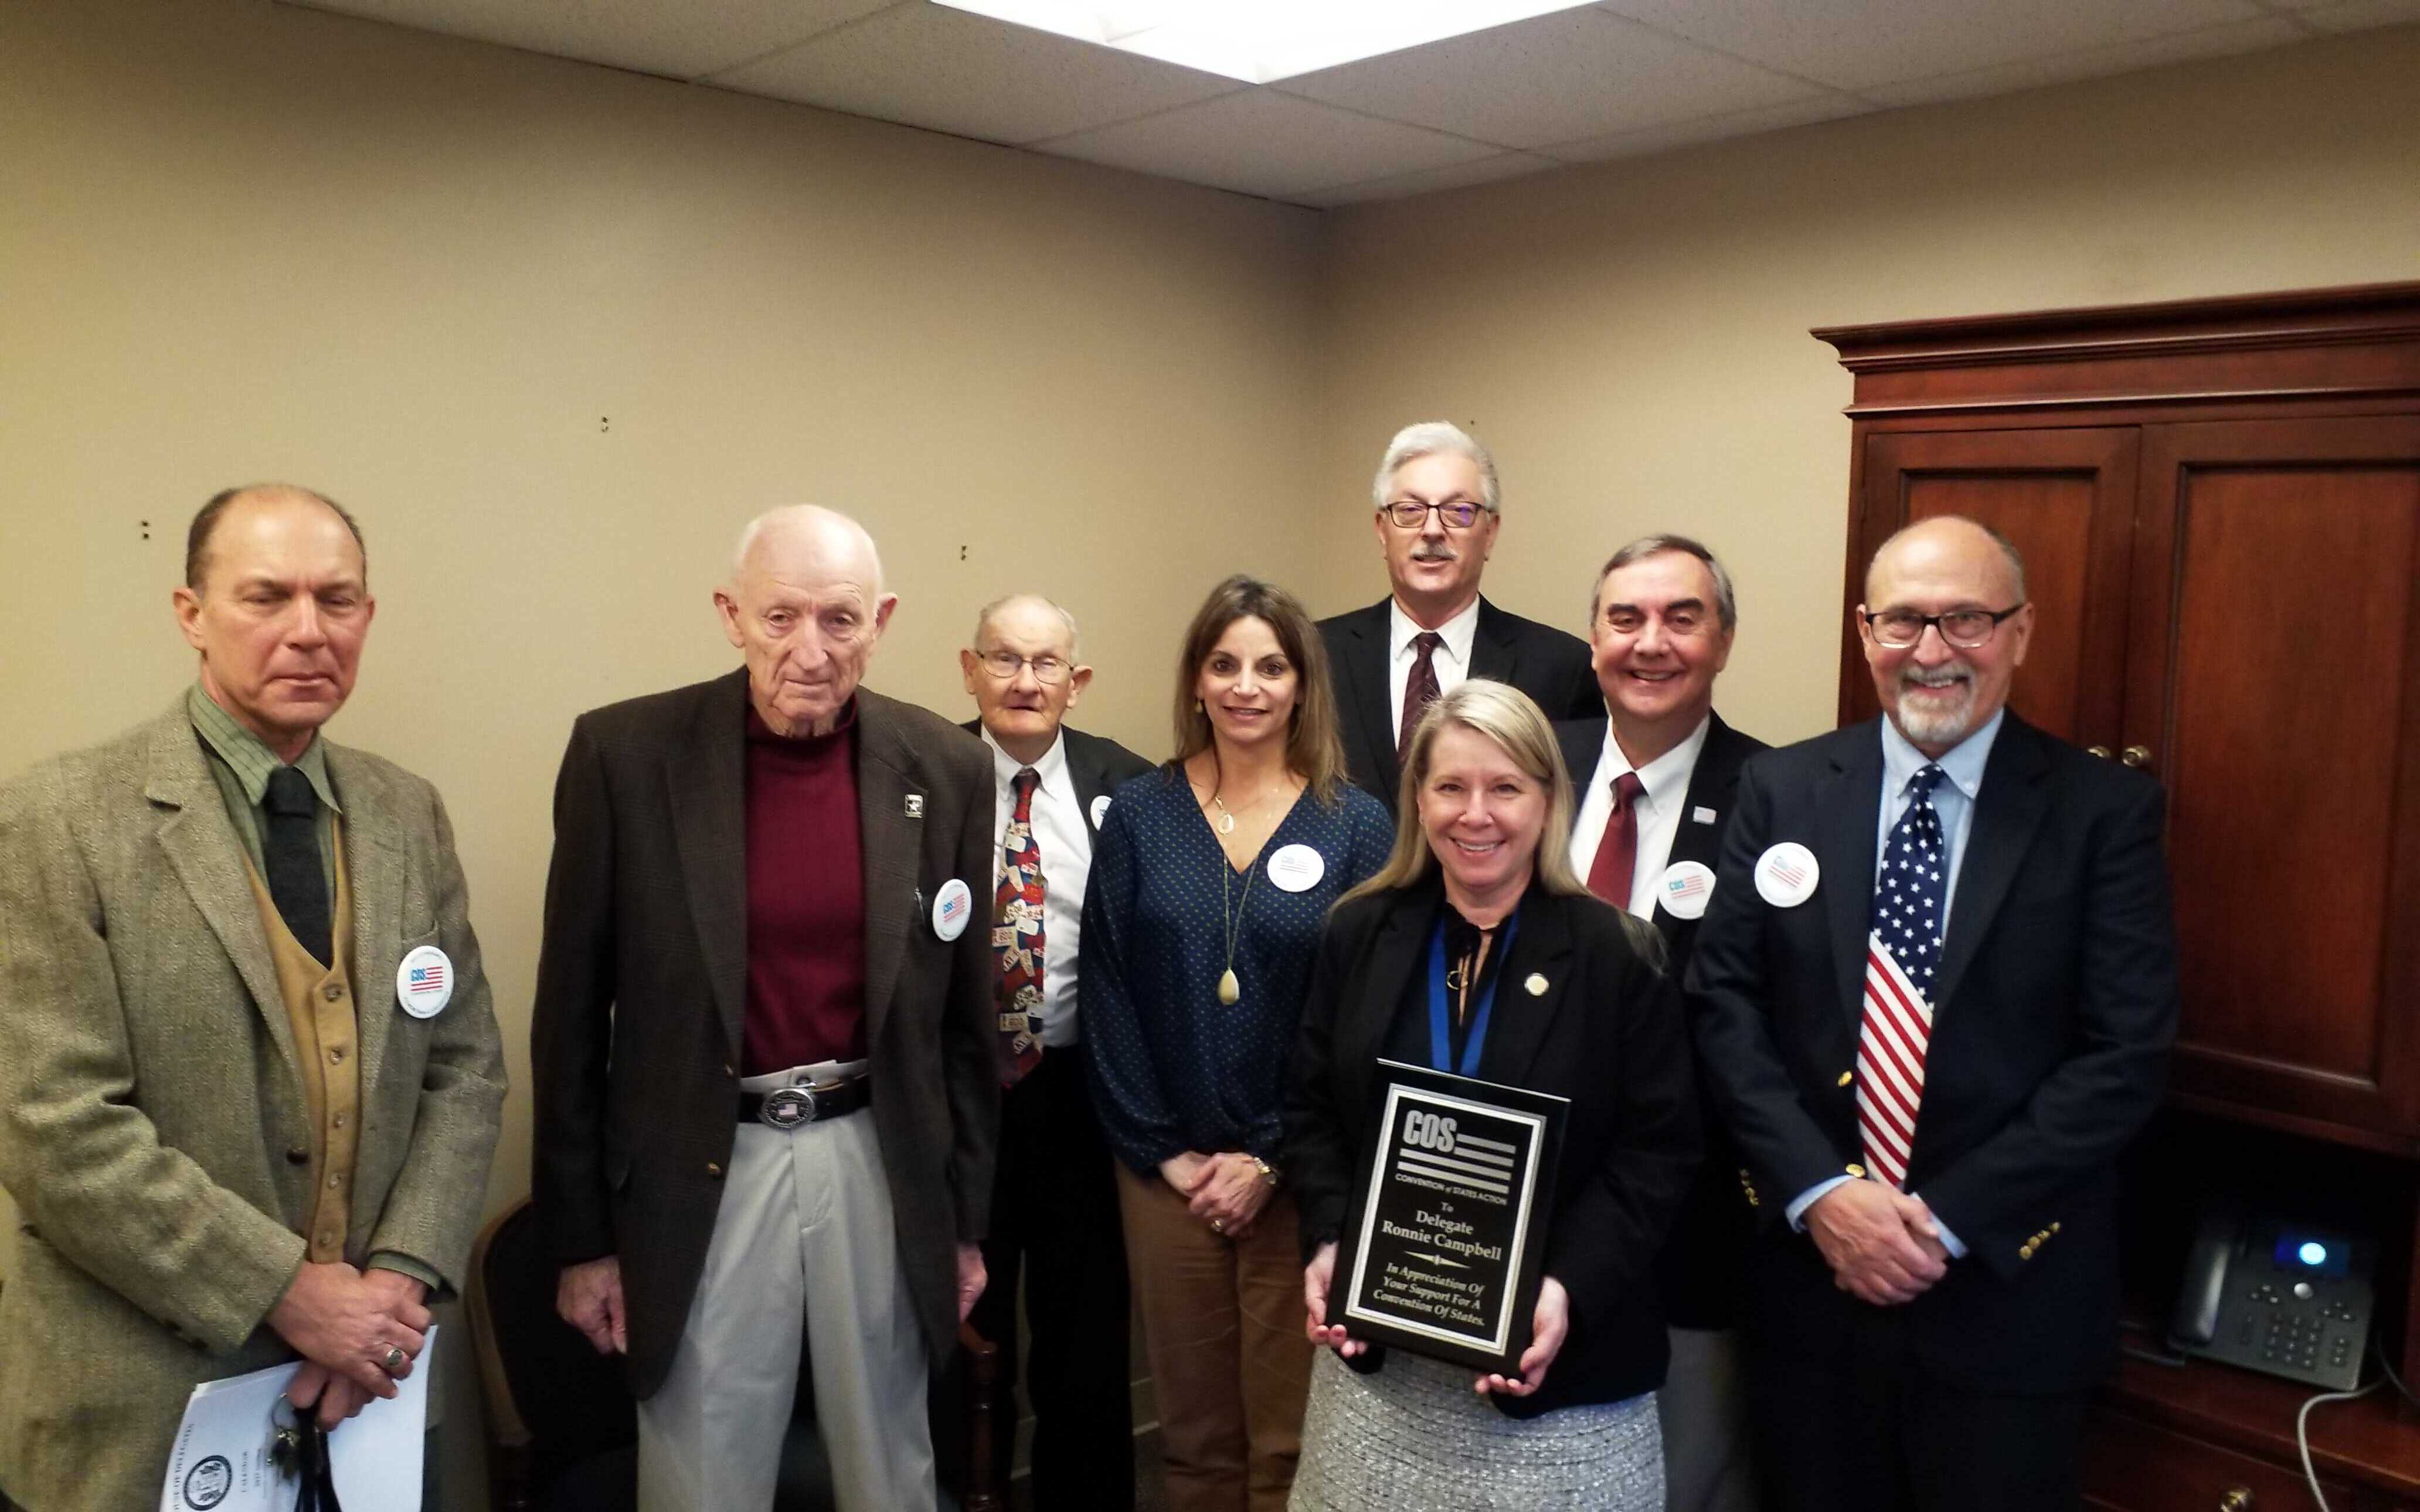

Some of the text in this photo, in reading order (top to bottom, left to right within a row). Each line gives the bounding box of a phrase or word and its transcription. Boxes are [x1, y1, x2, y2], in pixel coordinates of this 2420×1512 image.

[1403, 1109, 1457, 1152] COS
[1416, 1210, 1474, 1235] Delegate
[1441, 1201, 1454, 1213] To
[1382, 1220, 1502, 1260] Ronnie Campbell
[1384, 1275, 1481, 1310] Your Support For A
[1386, 1262, 1486, 1298] In Appreciation Of
[1373, 1289, 1433, 1313] Convention
[1434, 1304, 1451, 1319] Of
